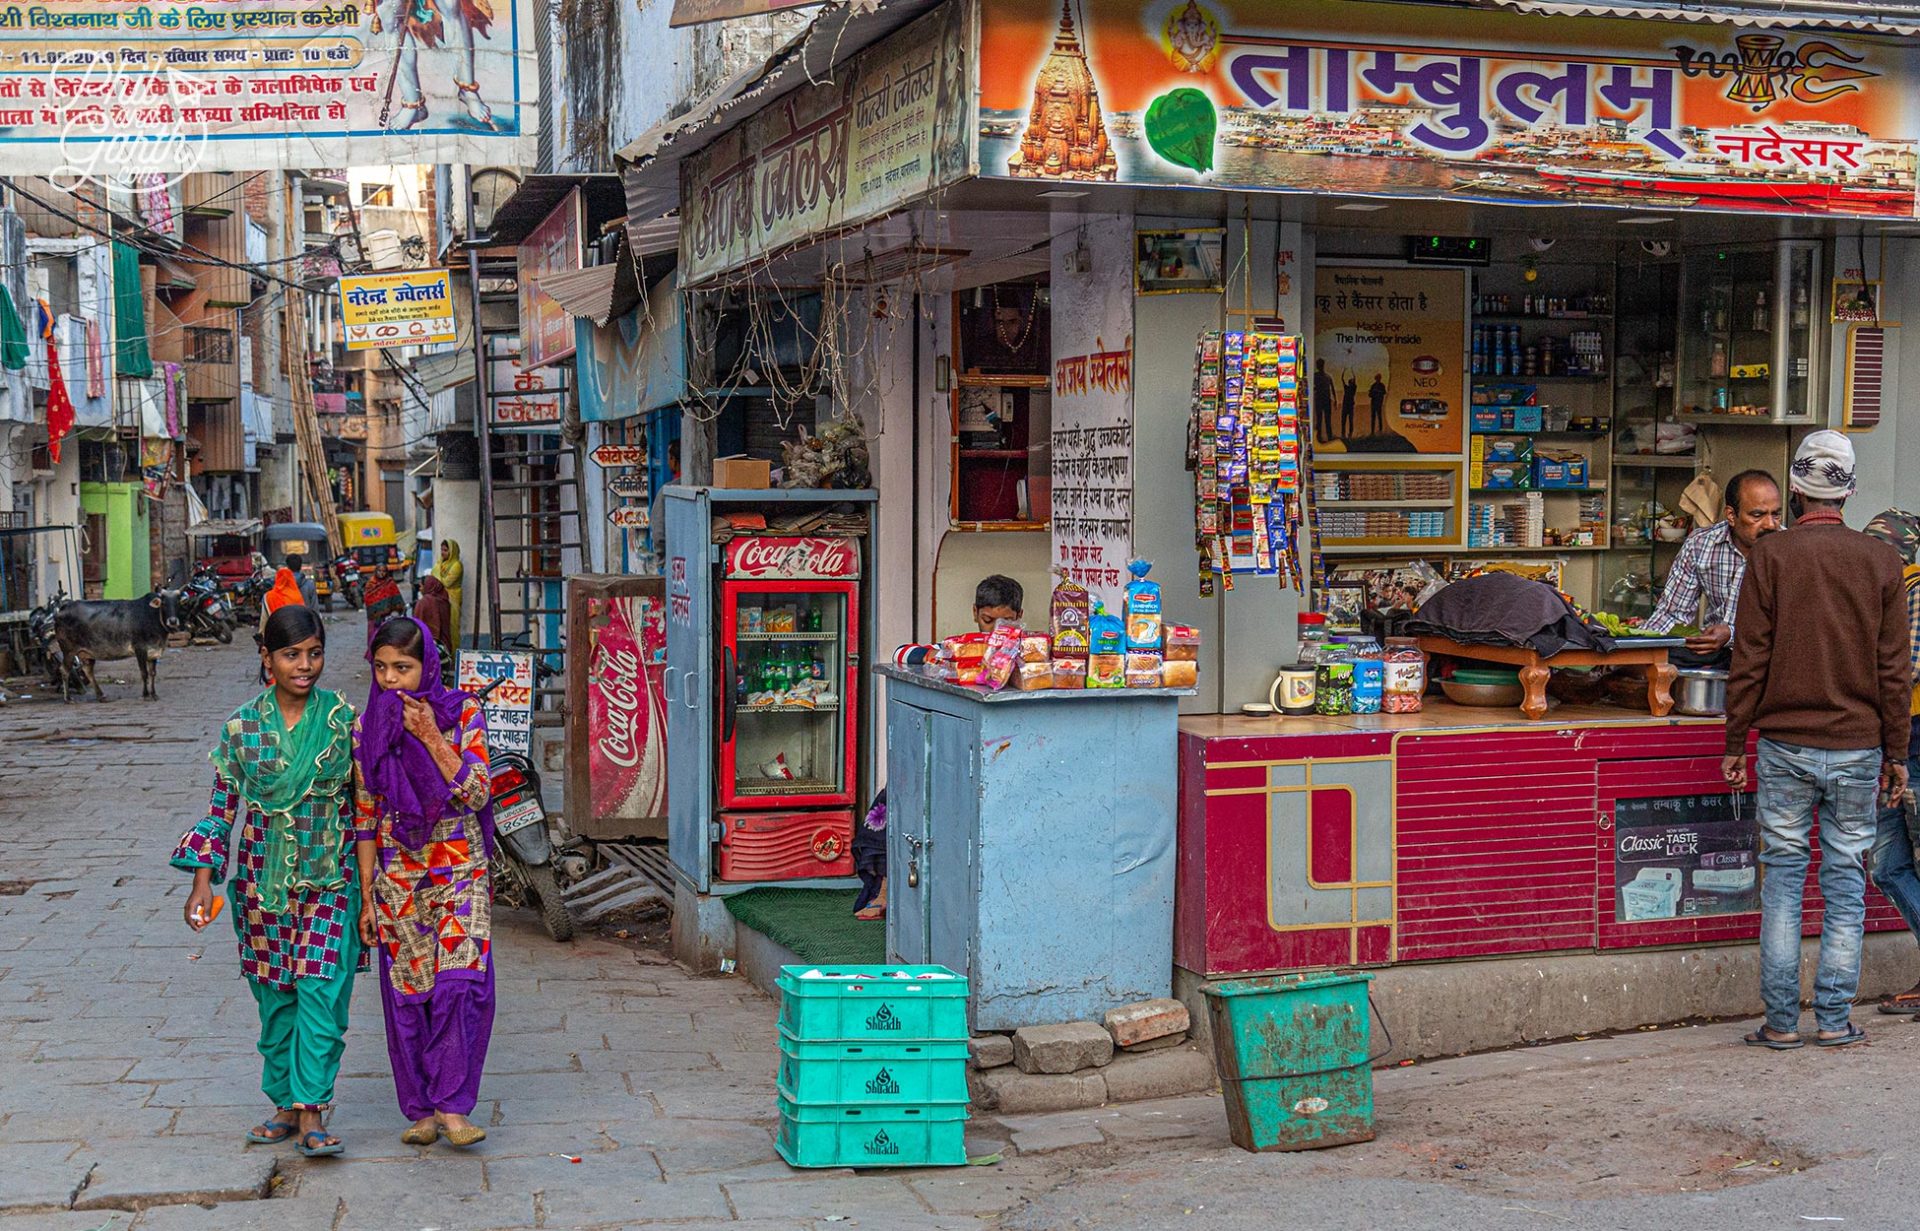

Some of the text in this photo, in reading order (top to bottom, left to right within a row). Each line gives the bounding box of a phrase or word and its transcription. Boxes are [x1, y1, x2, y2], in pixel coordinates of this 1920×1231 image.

[29, 7, 118, 27] विश्वनाथ
[124, 7, 152, 27] जी
[158, 8, 180, 27] के
[187, 7, 226, 29] लिए
[231, 11, 297, 29] प्रस्थान
[302, 5, 359, 25] करेगी
[165, 48, 208, 63] रविवार
[213, 49, 247, 61] समय
[303, 50, 320, 61] 10
[327, 44, 349, 60] बजे
[28, 77, 46, 97] से
[222, 76, 242, 95] के
[249, 74, 343, 94] जलाभिषेक
[349, 73, 378, 92] एवं
[239, 102, 320, 122] सम्मिलित
[1231, 46, 1687, 160] ताम्बुलम्
[1715, 127, 1863, 169] नदेसर
[347, 287, 388, 306] नरेन्द्र
[1336, 292, 1347, 310] से
[1352, 291, 1383, 310] कैंसर
[1387, 291, 1414, 311] होता
[1419, 291, 1428, 311] है
[1356, 322, 1402, 333] Made For
[1335, 333, 1422, 345] The Inventor Inside
[1056, 355, 1087, 397] अजय
[1414, 377, 1438, 388] NEO
[599, 643, 639, 768] Coca-Cola
[500, 710, 530, 726] साइज
[503, 729, 529, 747] साइज
[503, 811, 538, 832] 8652
[1620, 833, 1698, 853] Classic TASTE
